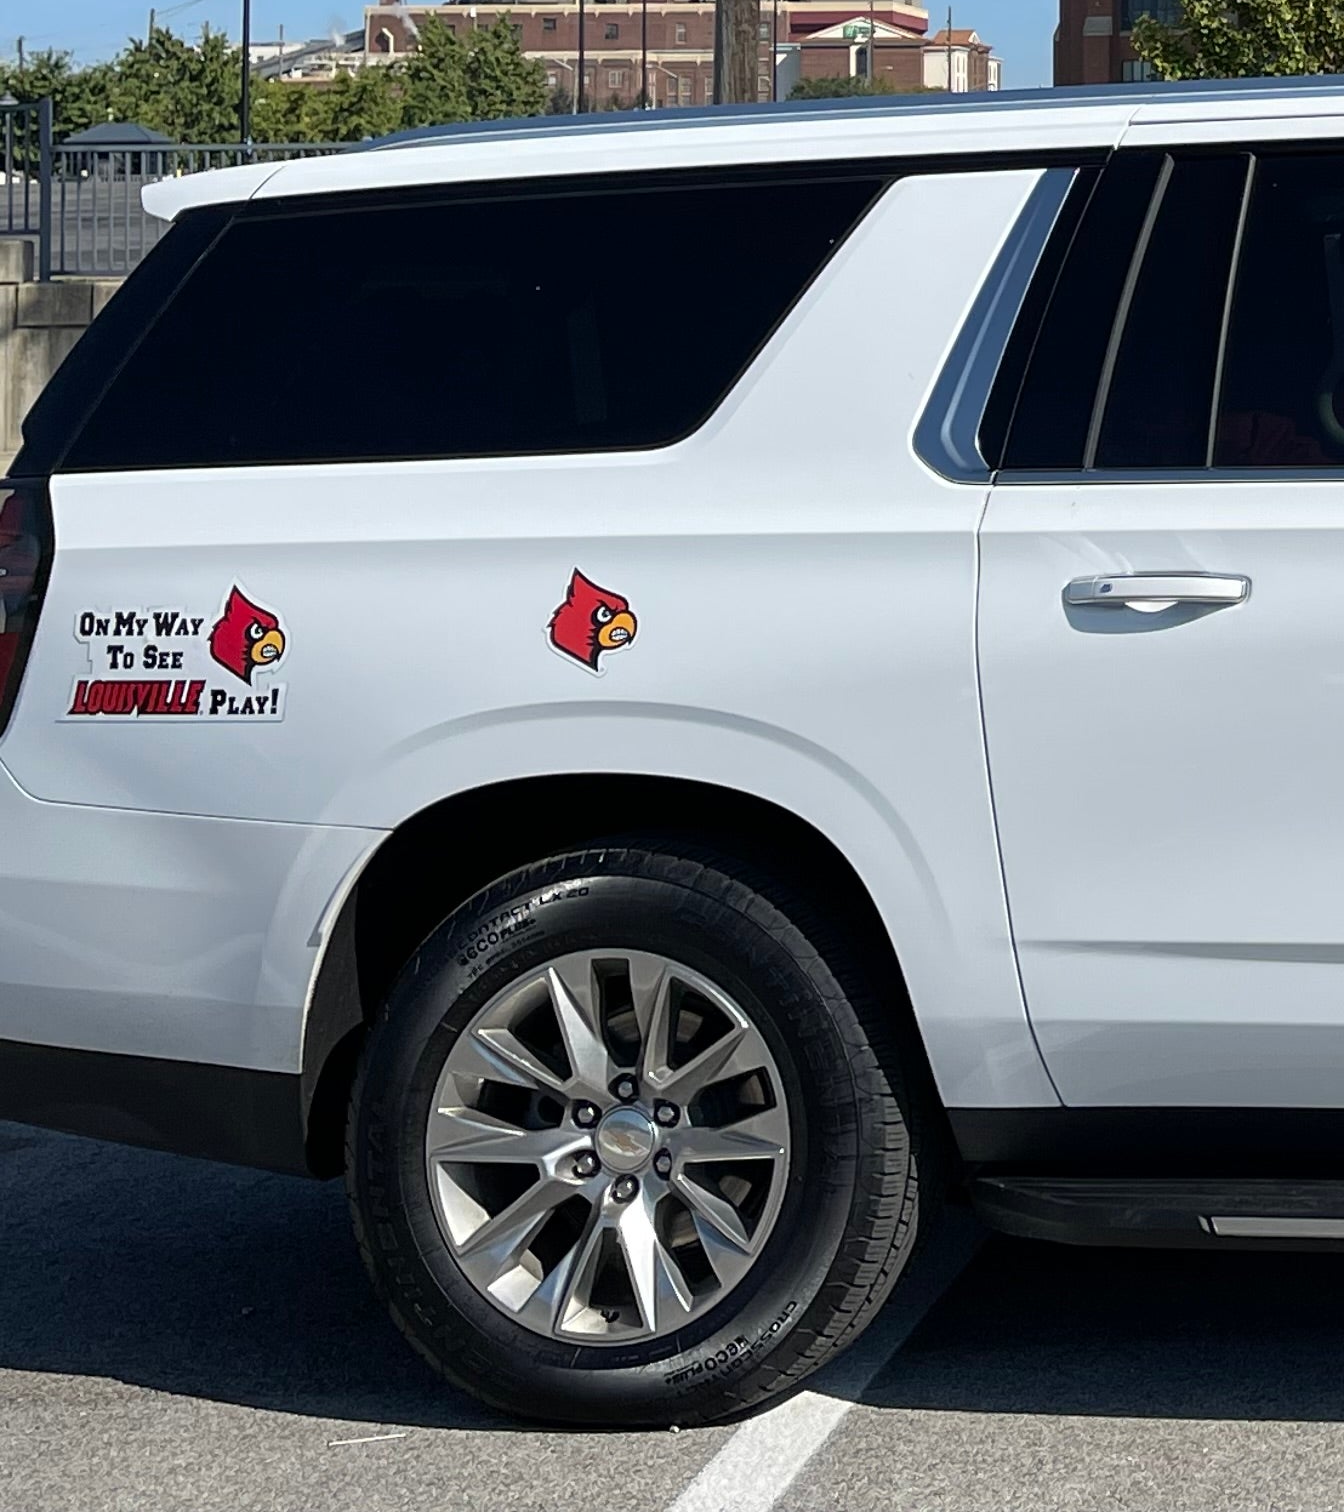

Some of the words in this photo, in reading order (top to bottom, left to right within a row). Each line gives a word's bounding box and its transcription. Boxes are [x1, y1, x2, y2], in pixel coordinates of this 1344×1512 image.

[80, 611, 110, 636] ON
[113, 611, 148, 636] MY
[153, 611, 204, 636] WAY
[107, 644, 134, 669] TO
[143, 644, 183, 669] SEE
[68, 680, 206, 716] LOUISVILLE
[209, 688, 279, 715] PLAY!
